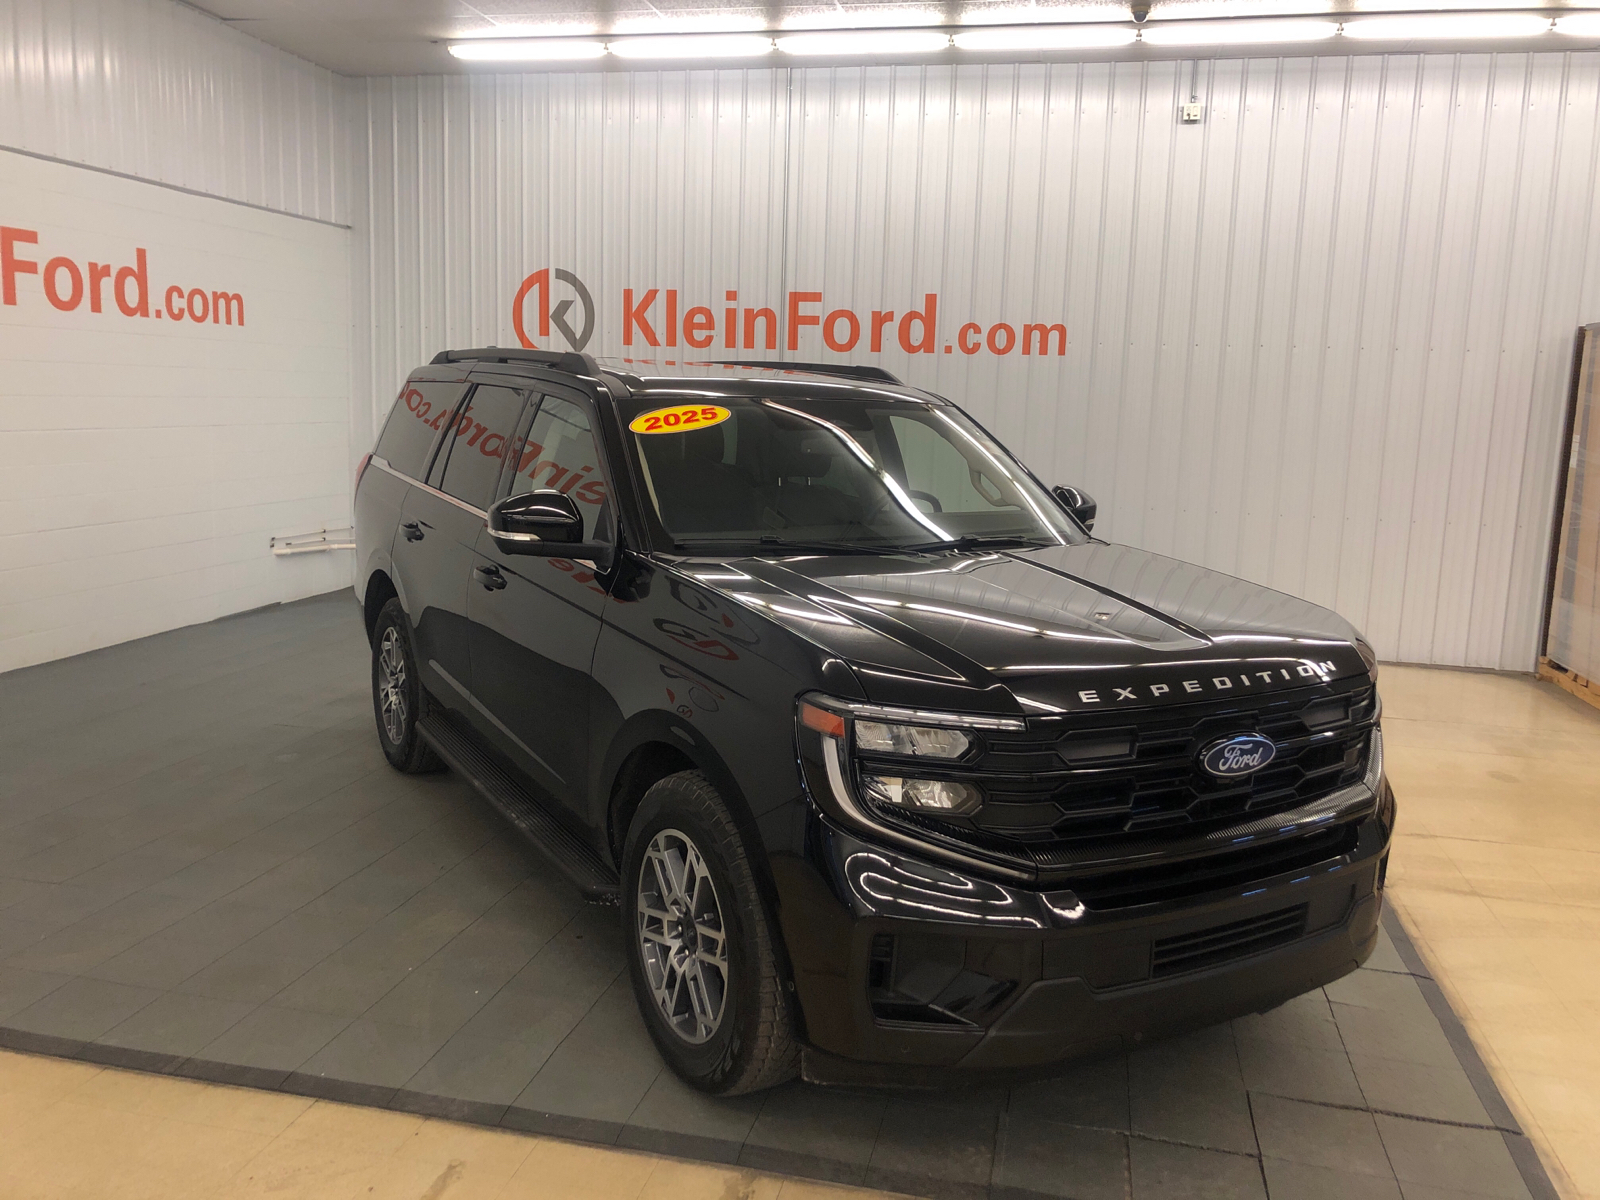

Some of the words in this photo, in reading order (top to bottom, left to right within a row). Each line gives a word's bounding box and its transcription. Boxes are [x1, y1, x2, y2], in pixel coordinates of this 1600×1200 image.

[0, 225, 245, 327] Ford.com
[622, 288, 1067, 356] KleinFord.com
[644, 408, 718, 431] 2025
[1078, 660, 1336, 703] EXPEDITION
[1218, 743, 1264, 771] Ford
